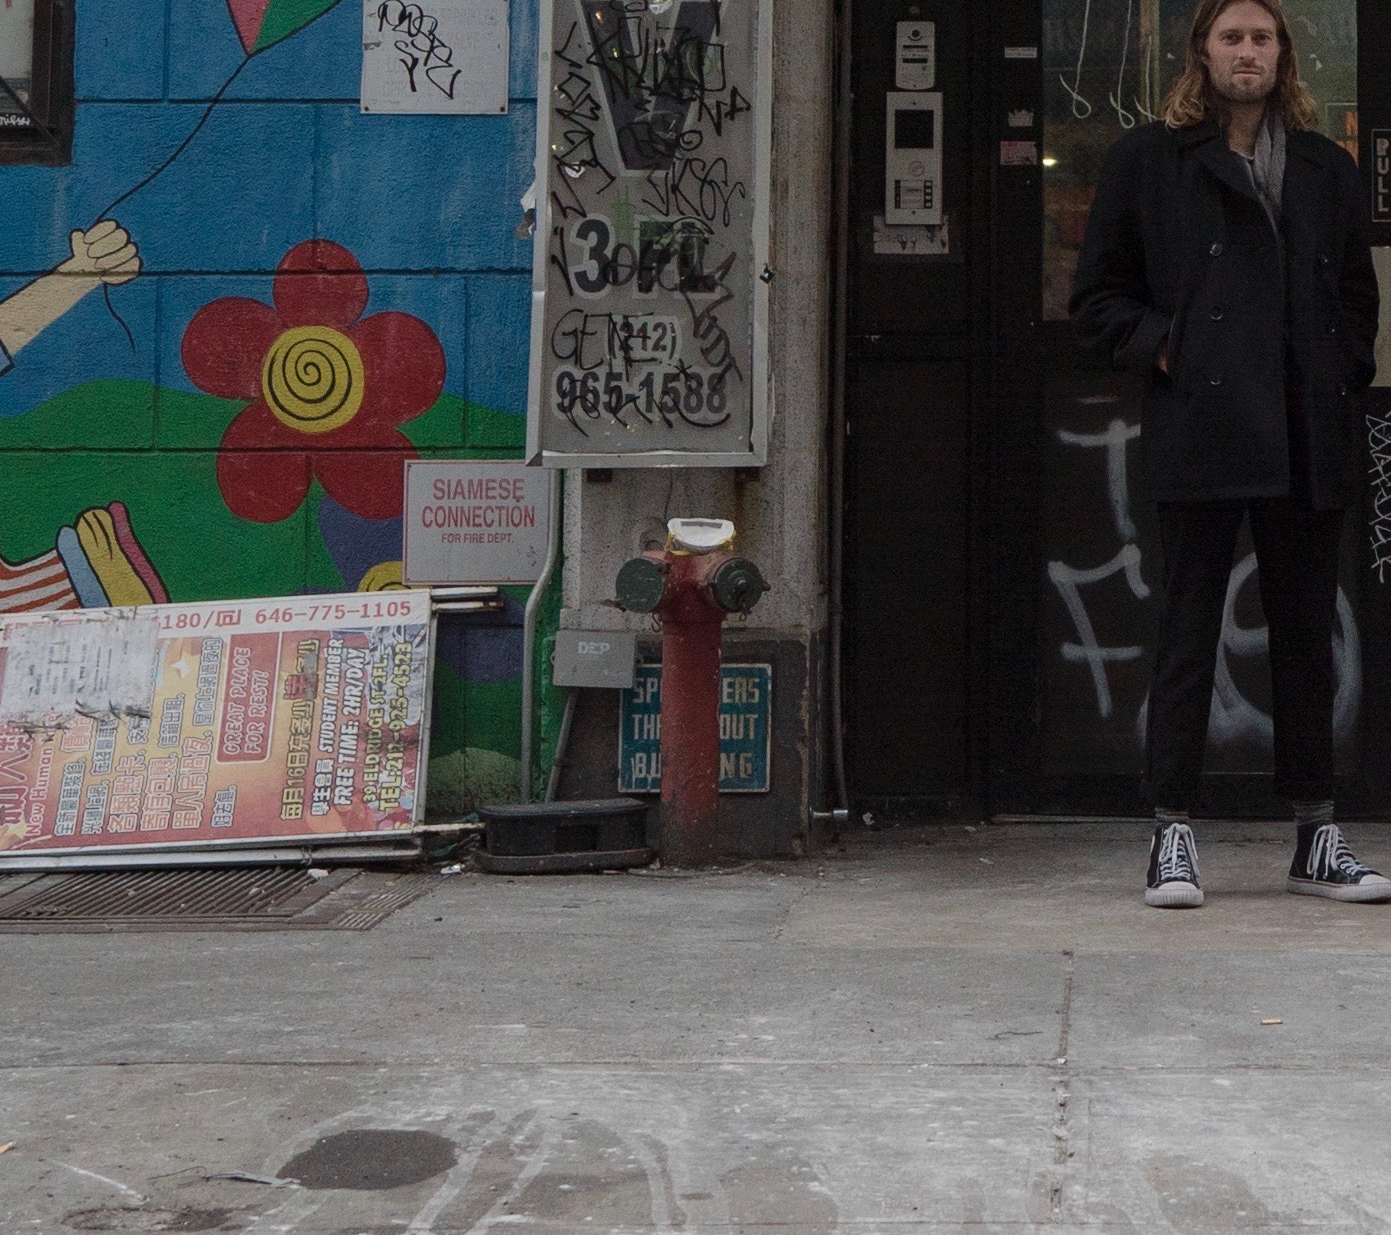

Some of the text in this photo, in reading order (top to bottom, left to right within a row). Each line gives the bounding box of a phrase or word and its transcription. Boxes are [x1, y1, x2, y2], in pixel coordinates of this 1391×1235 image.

[1374, 137, 1390, 213] PULL
[555, 370, 727, 415] 965-1588
[432, 478, 525, 501] SIAMESE
[421, 505, 535, 528] CONNECTION
[441, 532, 515, 543] FOR FIRE DEPT.
[254, 600, 412, 625] 646-775-1105
[324, 638, 344, 695] MEMBER
[224, 647, 251, 755] GREAT PLACE
[370, 688, 388, 705] ST
[632, 677, 761, 705] SPERS
[246, 669, 270, 754] FOR REST!
[319, 698, 339, 753] STUDENT
[334, 648, 366, 806] FREE TIME: 2HR/DAY
[632, 714, 759, 741] THOUT
[364, 708, 384, 781] ELDRIDGE
[30, 747, 54, 800] Human
[634, 752, 753, 780] BUNG
[363, 785, 377, 802] 39
[25, 803, 46, 837] New
